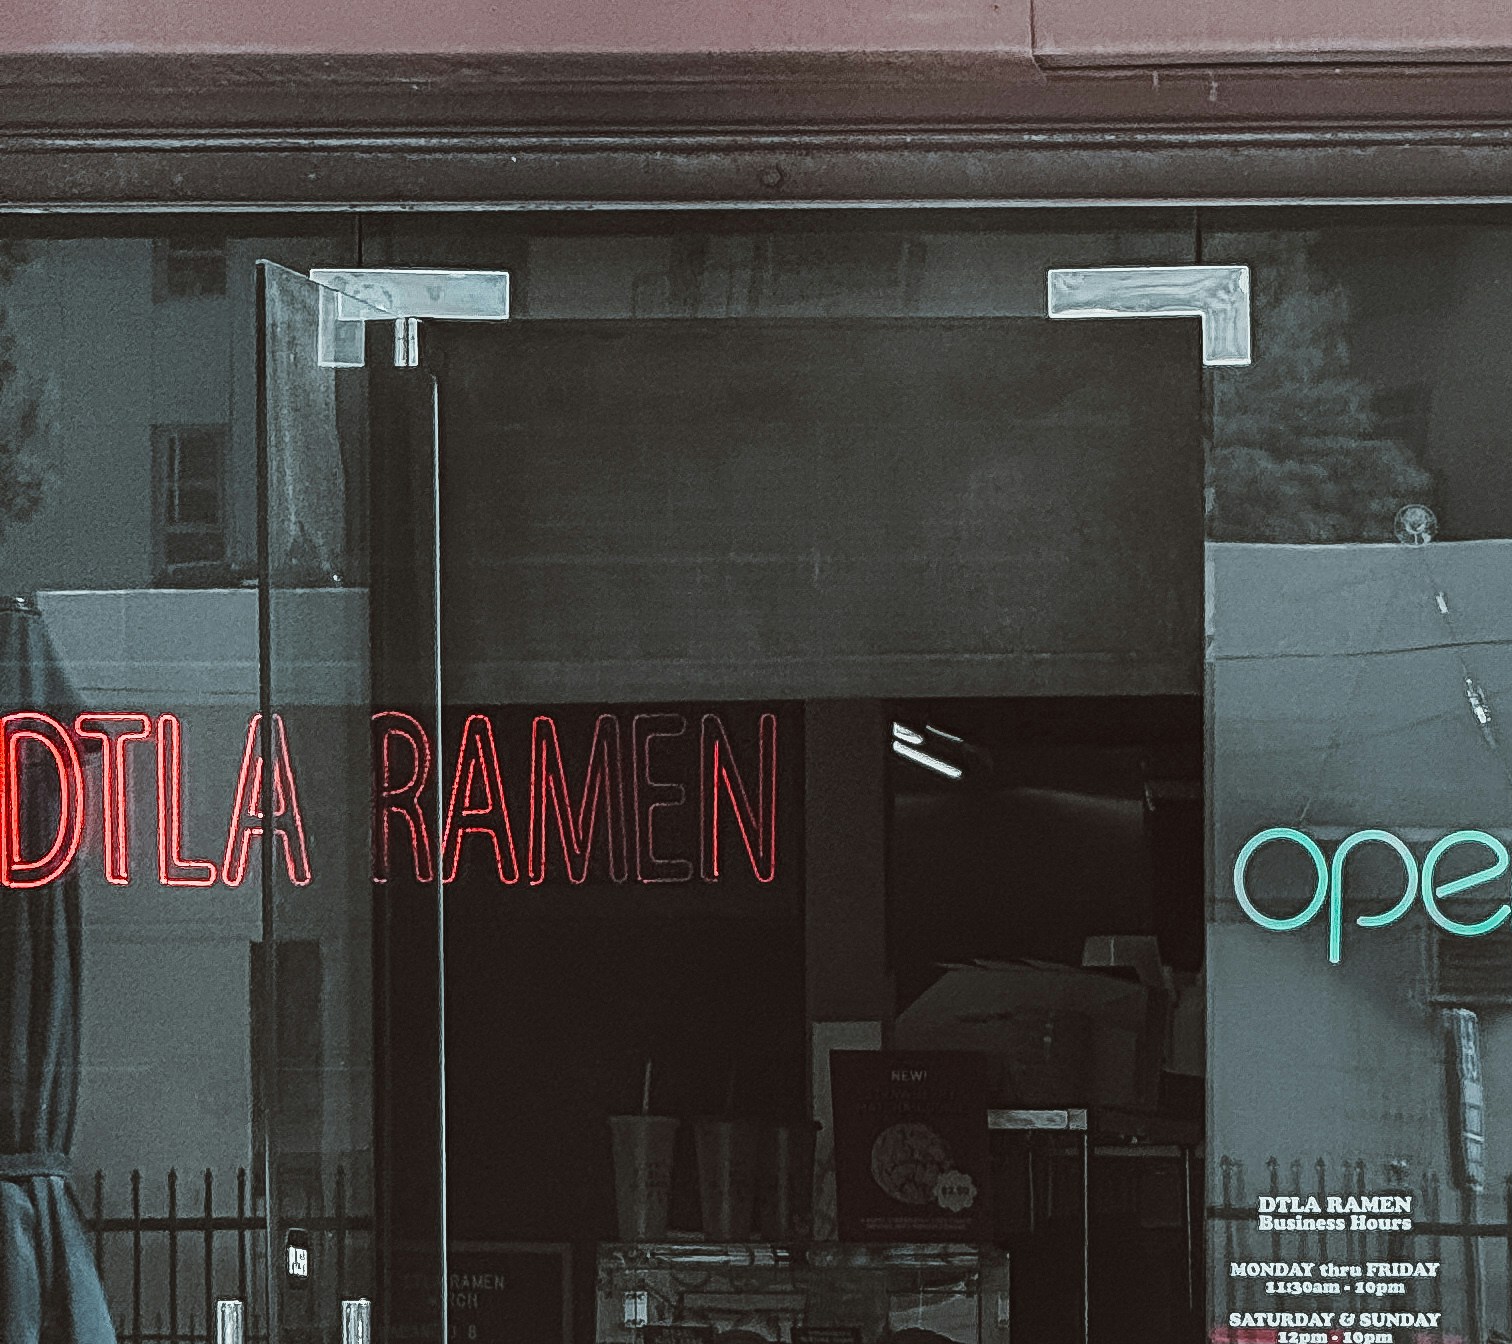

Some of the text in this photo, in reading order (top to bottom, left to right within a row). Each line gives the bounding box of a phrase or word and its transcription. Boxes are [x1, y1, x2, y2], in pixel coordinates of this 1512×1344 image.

[0, 711, 778, 887] DTLA RAMEN
[1258, 1196, 1412, 1213] DTLA RAMEN
[1258, 1215, 1412, 1231] Business Hours
[1230, 1262, 1441, 1277] MONDAY thru FRIDAY
[1265, 1281, 1341, 1295] 11:30am
[1354, 1281, 1405, 1297] 10pm
[1229, 1312, 1442, 1328] SATURDAY & SUNDAY
